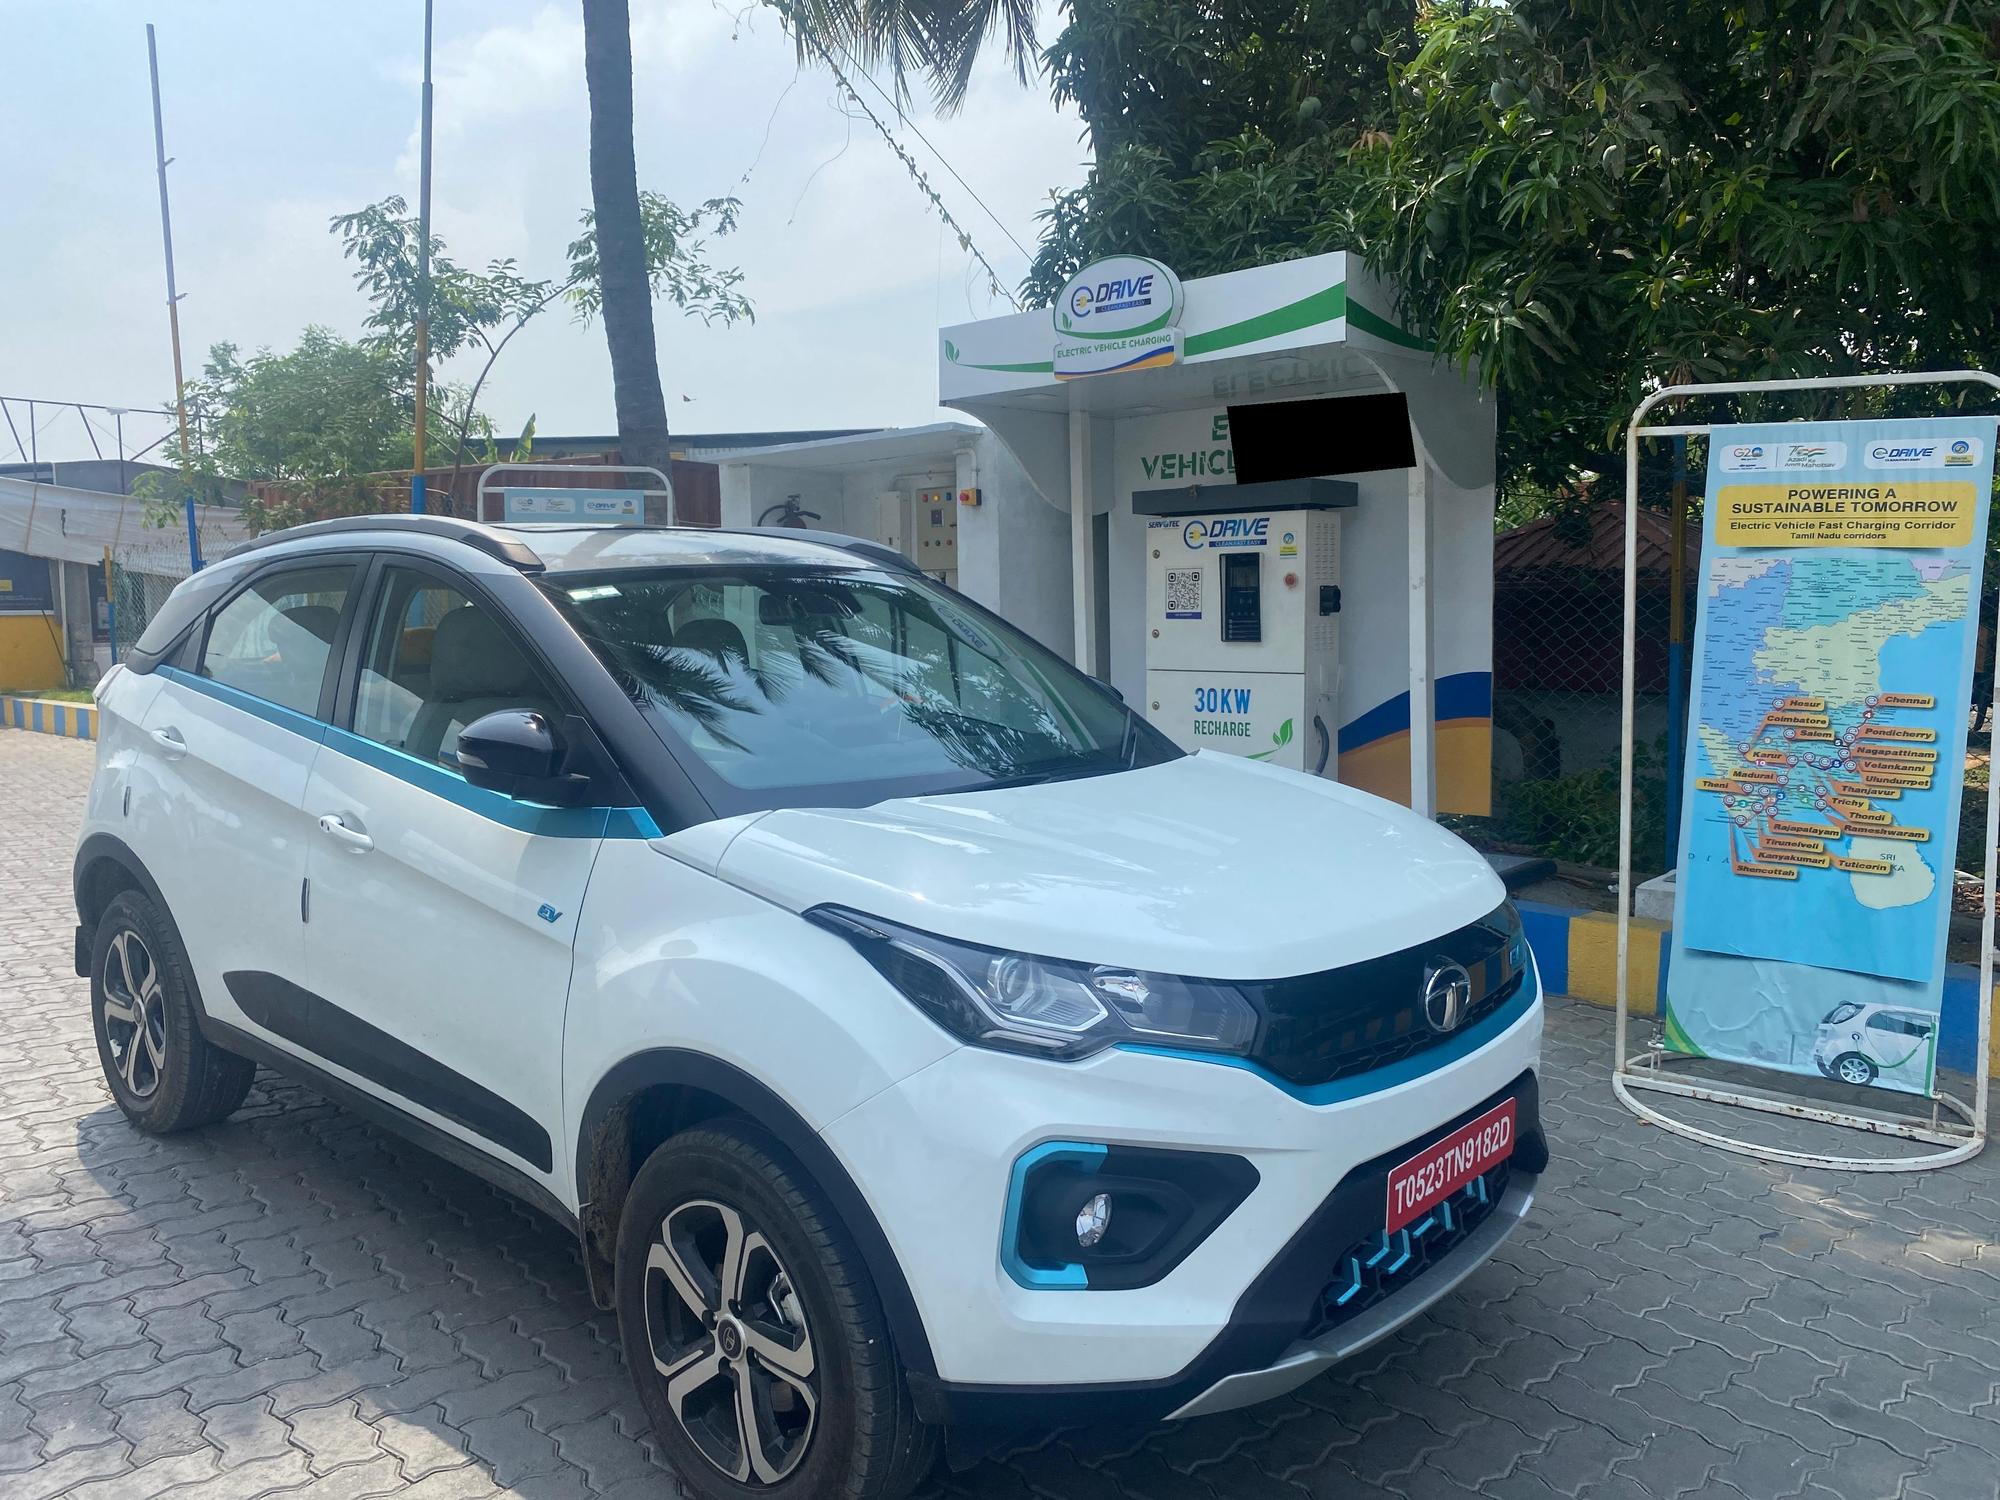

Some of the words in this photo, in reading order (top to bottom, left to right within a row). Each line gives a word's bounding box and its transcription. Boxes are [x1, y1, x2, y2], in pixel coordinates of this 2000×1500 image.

[1095, 274, 1154, 303] DRIVE
[1057, 346, 1092, 358] ELECTRIC
[1095, 340, 1127, 352] VEHICLE
[1129, 334, 1172, 347] CHARGING
[1889, 447, 1934, 458] DRIVE
[1141, 449, 1236, 480] VEHICL
[1788, 488, 1879, 500] POWERING
[1885, 488, 1897, 499] A
[1731, 501, 1846, 514] SUSTAINABLE
[1850, 500, 1958, 513] TOMORROW
[1209, 517, 1270, 538] DRIVE
[1730, 521, 1771, 530] Electric
[1774, 521, 1815, 530] Vehicle
[1818, 521, 1843, 530] Fast
[1846, 521, 1900, 531] Charging
[1904, 520, 1956, 530] Corridor
[1844, 532, 1887, 540] corridors
[1790, 700, 1821, 708] Hosur
[1885, 696, 1931, 705] Chennai
[1766, 715, 1827, 725] Coimbatore
[1194, 720, 1251, 737] RECHARGE
[1800, 729, 1832, 738] Salem
[1865, 728, 1932, 740] Pondicherry
[1752, 751, 1783, 760] Karur
[1856, 747, 1935, 759] Nagapattinam
[1864, 761, 1926, 772] Velankanni
[1732, 770, 1774, 780] Madurai
[1702, 780, 1729, 789] Theni
[1841, 785, 1896, 796] Thanjavur
[1831, 797, 1865, 808] Trichy
[1849, 811, 1886, 822] Thondi
[1773, 823, 1840, 838] Rajapalayam
[1843, 824, 1926, 839] Rameshwaram
[1765, 838, 1819, 850] Tirunelveli
[1758, 852, 1826, 866] Kanyakumari
[1880, 853, 1896, 861] SRI
[1736, 865, 1796, 877] Shencottah
[1839, 860, 1887, 871] Tuticorin
[1395, 1115, 1511, 1215] T0523TN9182D
